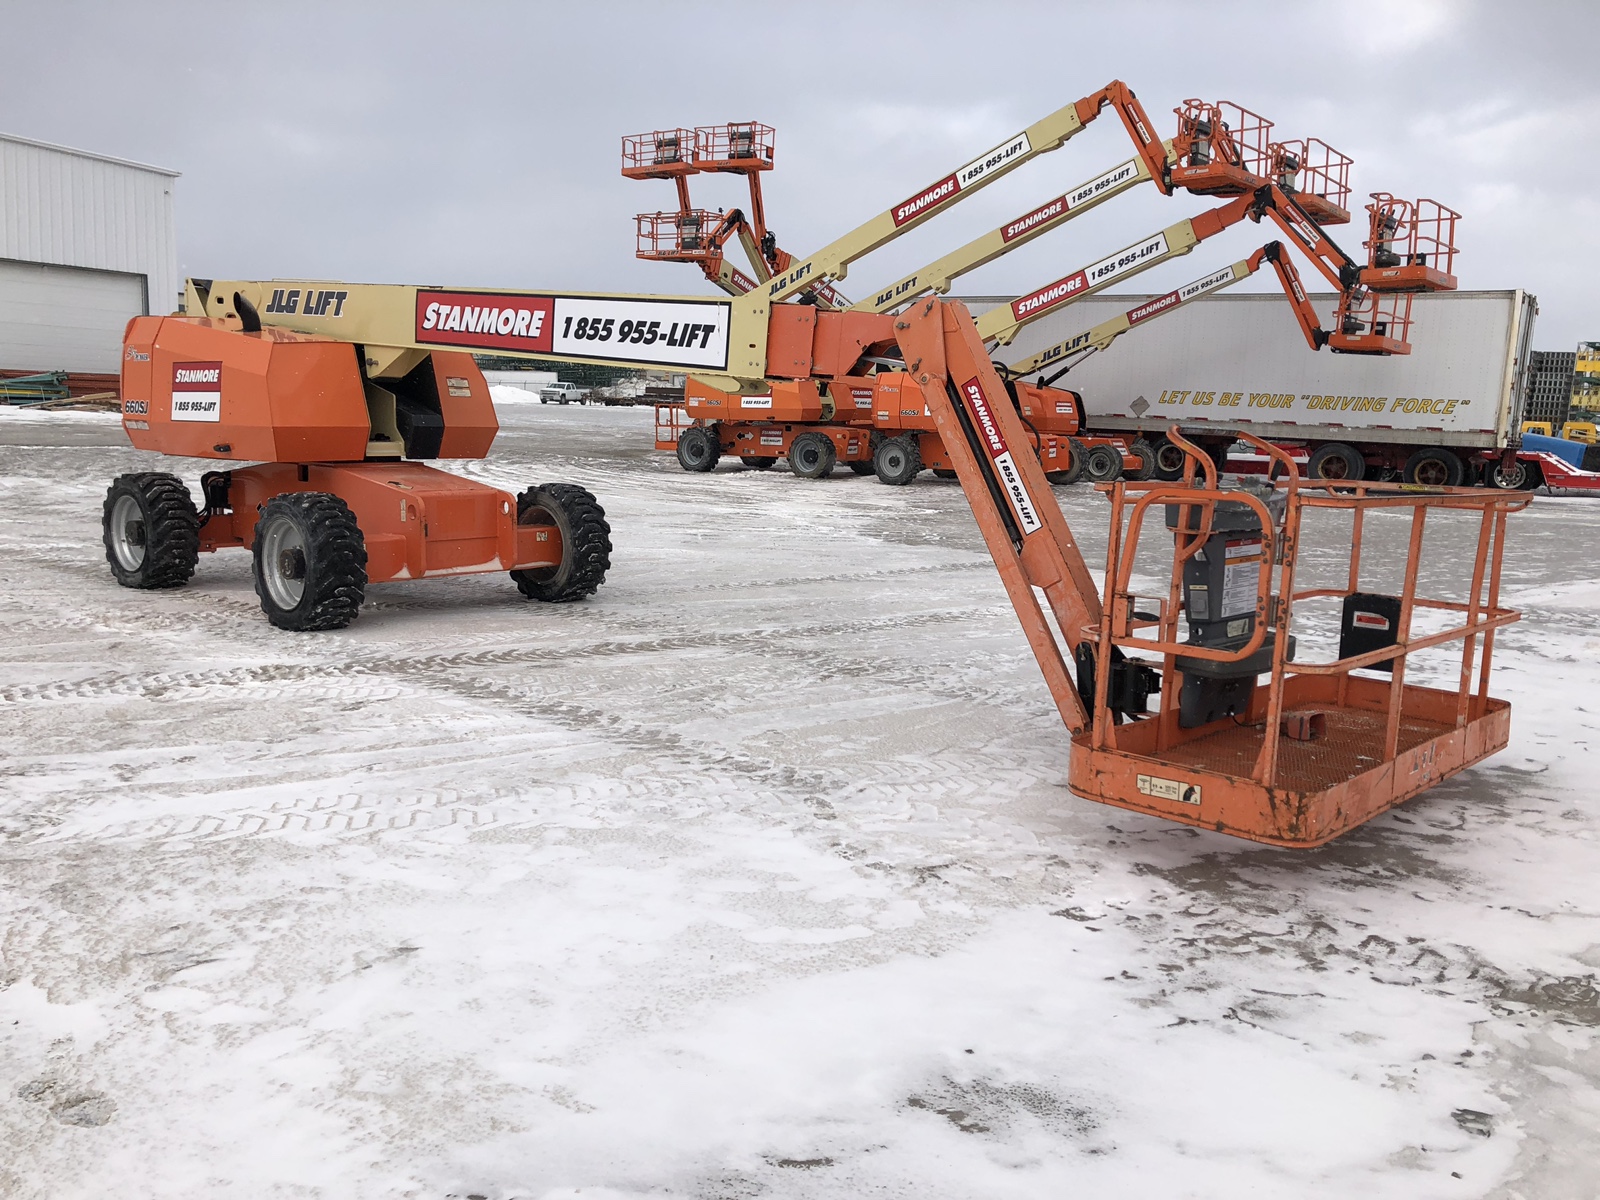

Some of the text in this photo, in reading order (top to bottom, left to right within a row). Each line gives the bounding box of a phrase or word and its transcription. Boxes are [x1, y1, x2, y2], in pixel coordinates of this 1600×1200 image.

[985, 140, 1024, 169] 955-LIFT
[1094, 167, 1131, 192] 955-LIFT
[897, 179, 955, 221] STANMORE
[1007, 201, 1062, 237] STANMORE
[1117, 241, 1161, 268] 955-LIFT
[769, 262, 812, 297] JLG LIFT
[875, 276, 918, 307] JLG LIFT
[1200, 271, 1230, 289] 955-LIFT
[265, 289, 347, 316] JLG LIFT
[1018, 276, 1083, 315] STANMORE
[1131, 294, 1177, 321] STANMORE
[422, 302, 546, 338] STANMORE
[617, 319, 716, 349] 955-LIFT
[1040, 331, 1091, 363] JLG LIFT
[175, 369, 220, 383] STANMORE
[125, 400, 149, 415] 660SJ
[190, 401, 217, 411] 955-LIFT
[1158, 390, 1191, 405] LET
[1191, 391, 1216, 406] US
[1218, 392, 1244, 407] BE
[1248, 393, 1296, 408] YOUR
[967, 385, 1003, 451] STANMORE
[1011, 485, 1036, 526] 955-LIFT
